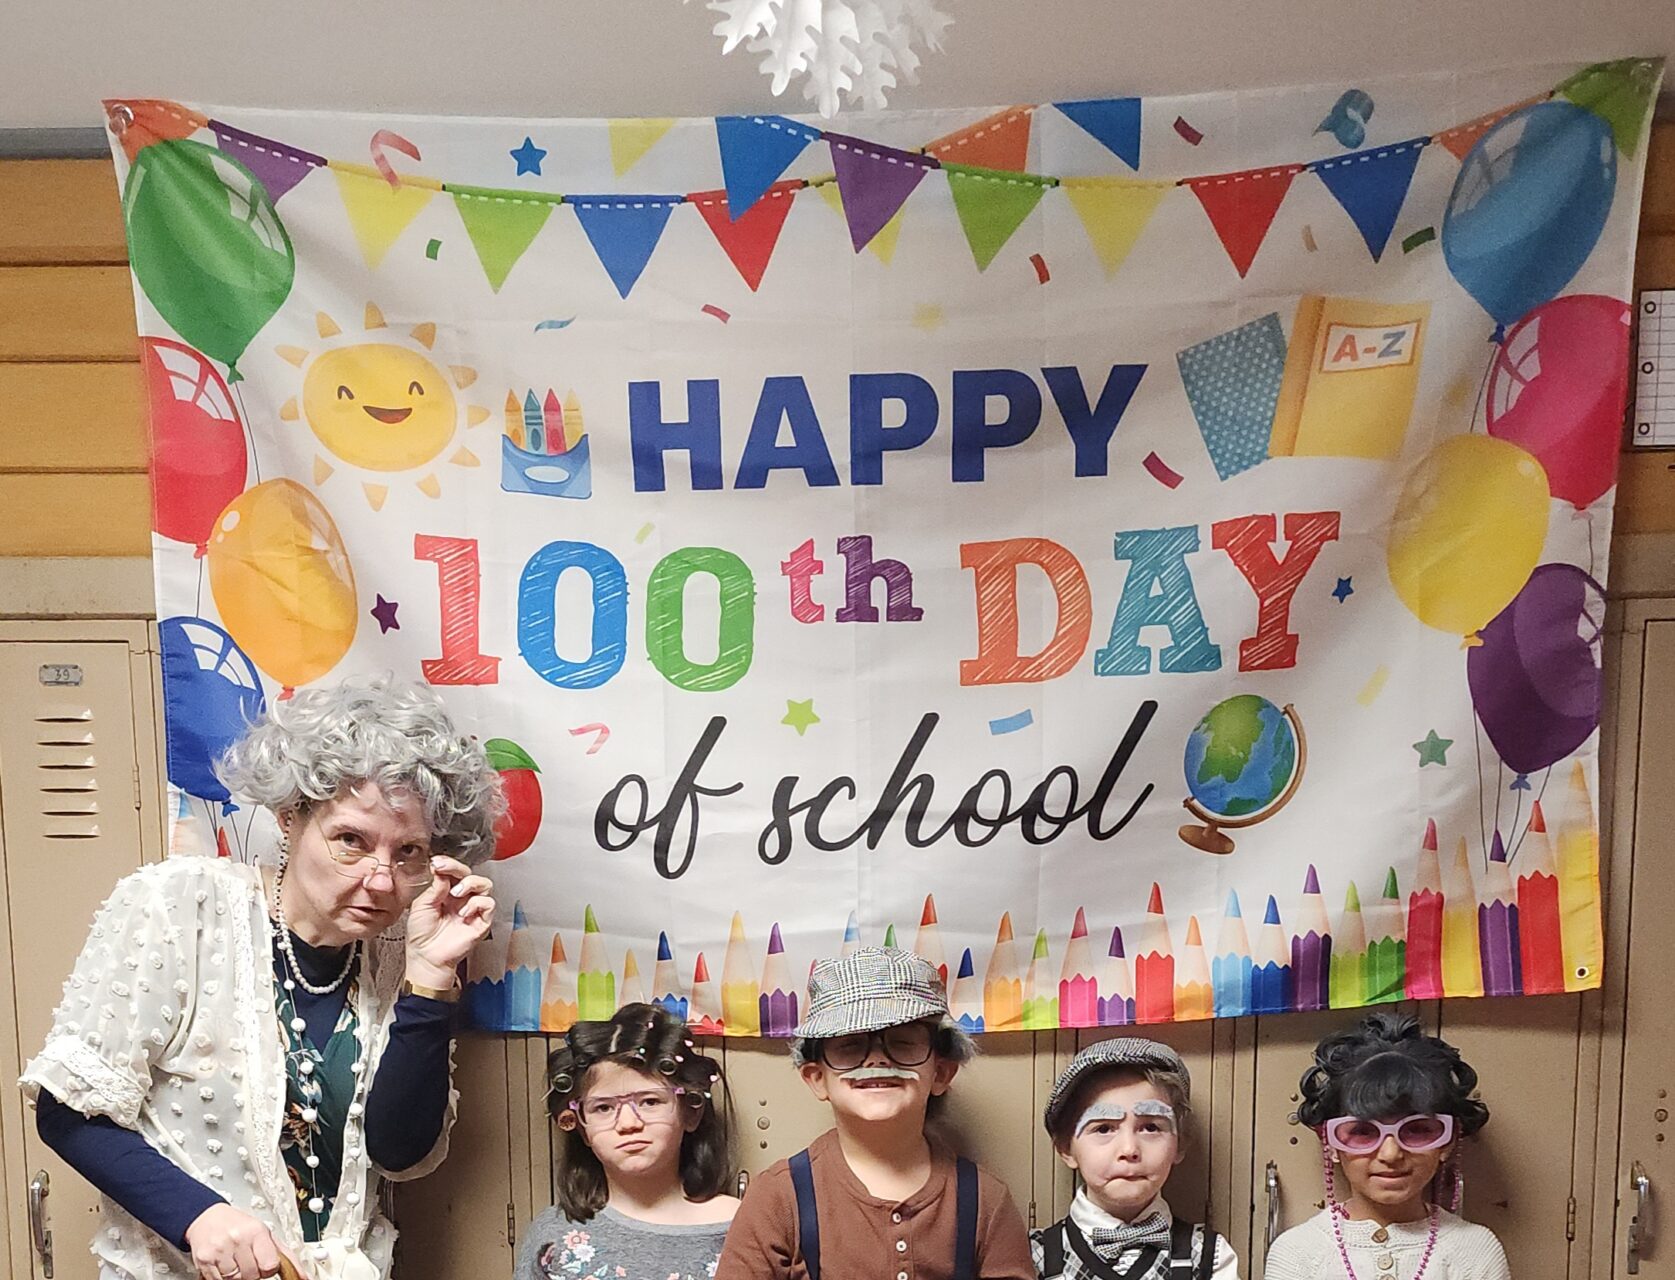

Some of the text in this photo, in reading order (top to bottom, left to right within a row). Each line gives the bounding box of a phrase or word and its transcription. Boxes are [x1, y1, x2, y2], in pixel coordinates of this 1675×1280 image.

[1331, 330, 1406, 363] A-Z
[627, 363, 1149, 493] HAPPY
[414, 511, 1341, 693] 100th DAY
[594, 700, 1159, 880] of school
